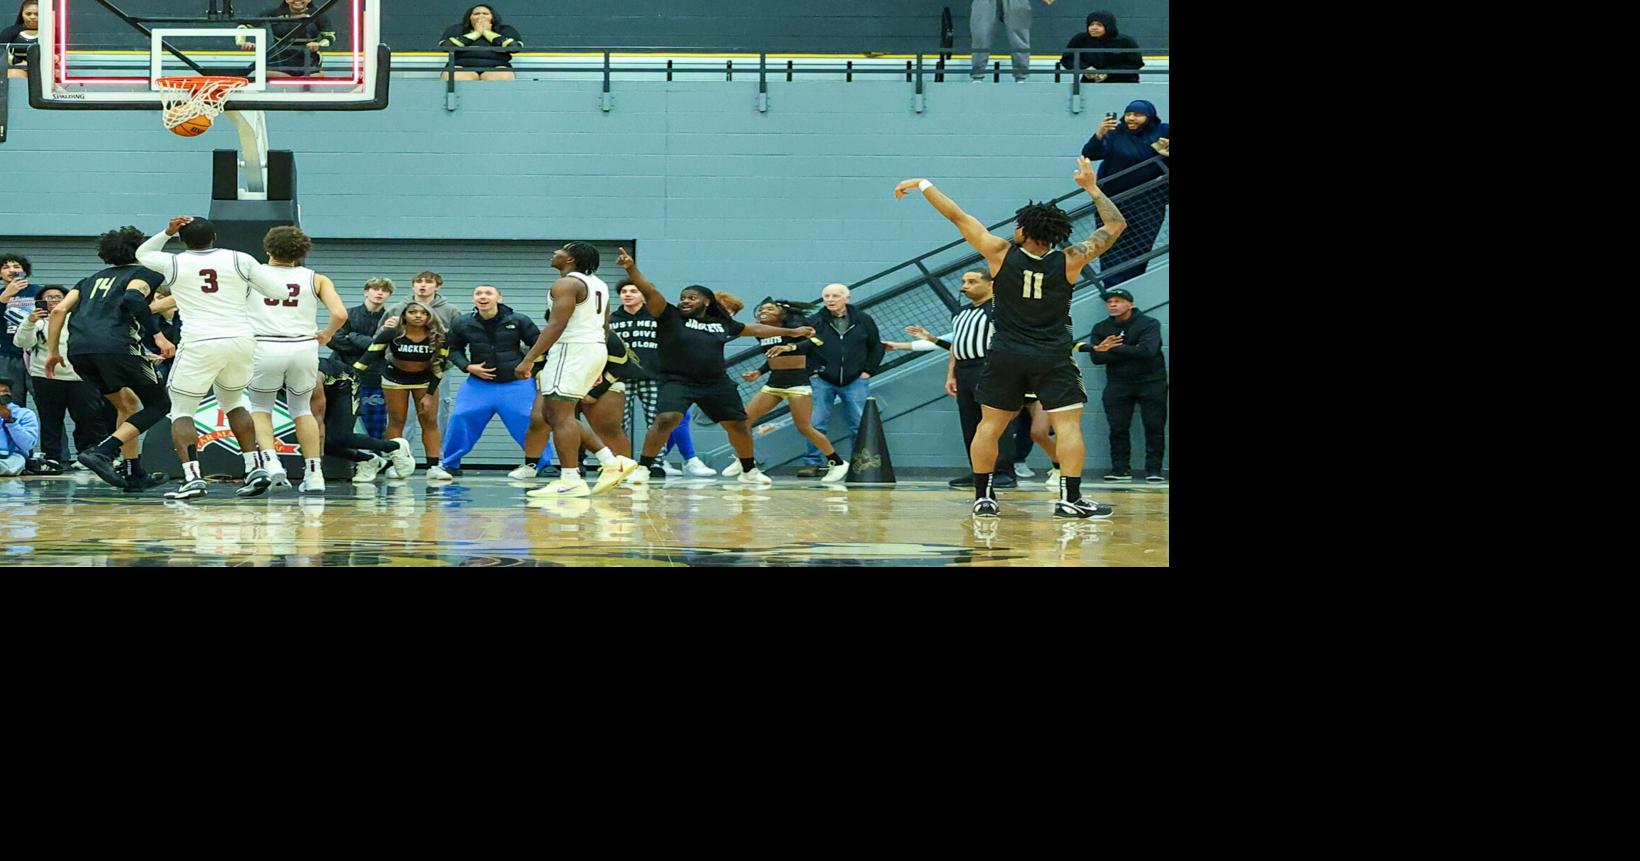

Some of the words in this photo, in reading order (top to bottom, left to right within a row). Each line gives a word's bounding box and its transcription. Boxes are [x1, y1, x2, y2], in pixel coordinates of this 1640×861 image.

[89, 276, 117, 299] 14
[199, 268, 219, 293] 3
[1022, 269, 1044, 299] 11
[264, 284, 300, 306] 2
[632, 330, 657, 339] GIVE
[685, 318, 725, 333] JACKETS
